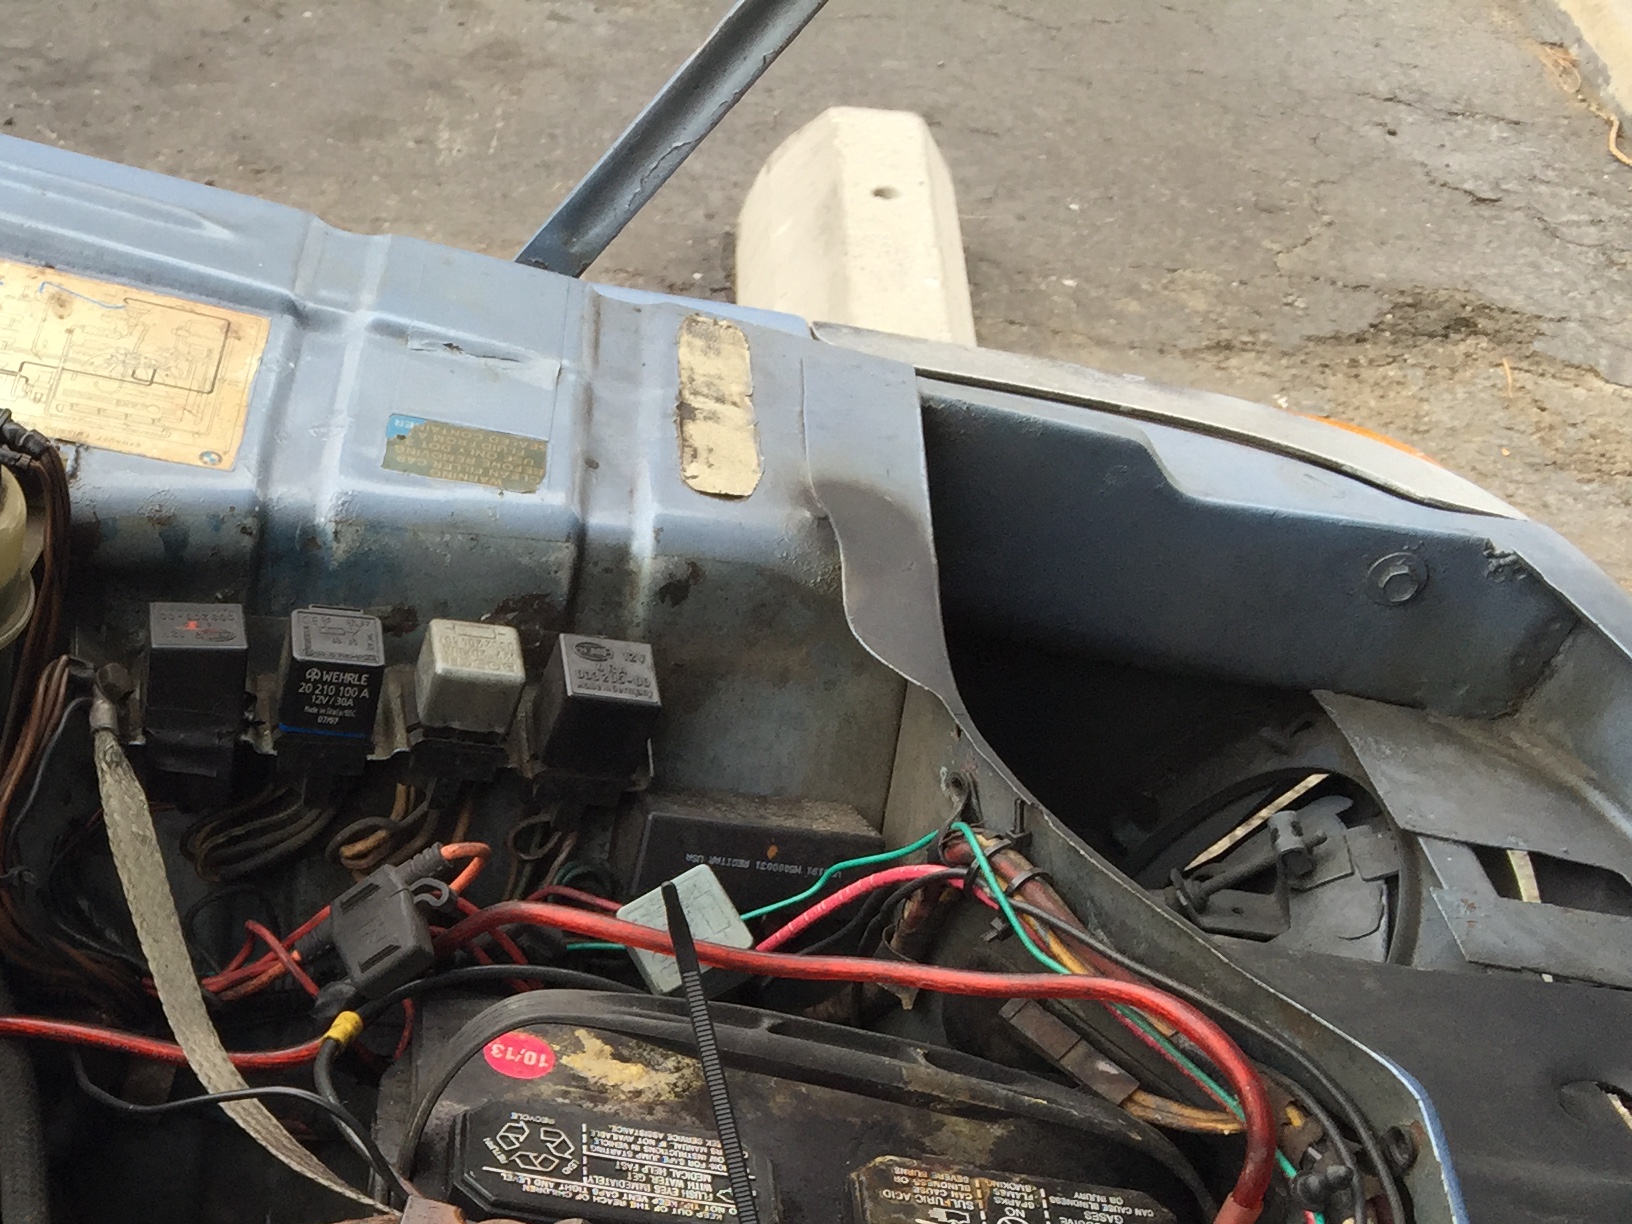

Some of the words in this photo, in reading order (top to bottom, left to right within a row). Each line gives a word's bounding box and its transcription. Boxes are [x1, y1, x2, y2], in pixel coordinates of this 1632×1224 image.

[418, 431, 428, 439] A
[421, 440, 451, 452] DOT
[433, 435, 476, 449] FROM
[394, 445, 476, 464] REMOVING
[457, 448, 497, 459] ONLY
[481, 442, 526, 456] FLUID
[396, 456, 427, 466] CAP
[504, 456, 534, 467] USE
[433, 461, 483, 475] FILLER
[481, 459, 544, 476] BEFORE
[429, 468, 502, 487] WARNING
[489, 469, 539, 484] CLEAN
[323, 670, 370, 685] WEHRLE
[298, 682, 313, 693] 20
[315, 684, 335, 695] 210
[339, 686, 358, 698] 100
[359, 688, 369, 698] A
[311, 695, 329, 704] 12V
[336, 698, 354, 707] 30A
[490, 1043, 548, 1068] 10/13
[509, 1112, 556, 1124] RECYCLE
[589, 1145, 634, 1158] STARTING
[635, 1153, 659, 1162] JUMP
[615, 1162, 638, 1170] FAST
[641, 1165, 667, 1175] HELP
[626, 1172, 646, 1182] GET
[669, 1169, 712, 1182] MEDICAL
[893, 1166, 928, 1178] BURNS
[930, 1172, 970, 1183] SEVERE
[500, 1173, 531, 1185] LEVEL
[533, 1179, 555, 1188] AND
[588, 1176, 651, 1192] IMMEDIATELY
[893, 1176, 909, 1184] OR
[558, 1183, 588, 1193] TIGHT
[653, 1185, 679, 1196] EYES
[687, 1181, 713, 1192] WITH
[912, 1178, 971, 1192] BLINDNESS
[521, 1184, 573, 1198] CHILDREN
[591, 1188, 619, 1198] CAPS
[681, 1190, 713, 1201] FLUSH
[882, 1189, 912, 1201] ACID
[912, 1186, 948, 1196] CAUSE
[950, 1190, 973, 1200] CAN
[992, 1188, 1033, 1200] FLAMES
[1073, 1191, 1107, 1202] INJURY
[574, 1193, 590, 1201] OF
[592, 1196, 627, 1207] REACH
[622, 1193, 648, 1202] VENT
[914, 1194, 974, 1210] SULFURIC
[993, 1196, 1035, 1209] SPARKS
[1109, 1196, 1124, 1205] OR
[629, 1201, 650, 1210] THE
[651, 1198, 678, 1208] KEEP
[1048, 1196, 1100, 1210] BLINDNESS
[671, 1208, 694, 1217] OUT
[704, 1205, 726, 1214] NOT
[1004, 1207, 1026, 1218] NO
[1101, 1204, 1132, 1215] CAUSE
[1134, 1208, 1154, 1217] CAN
[696, 1212, 723, 1220] KEEP
[1083, 1210, 1124, 1224] GASES
